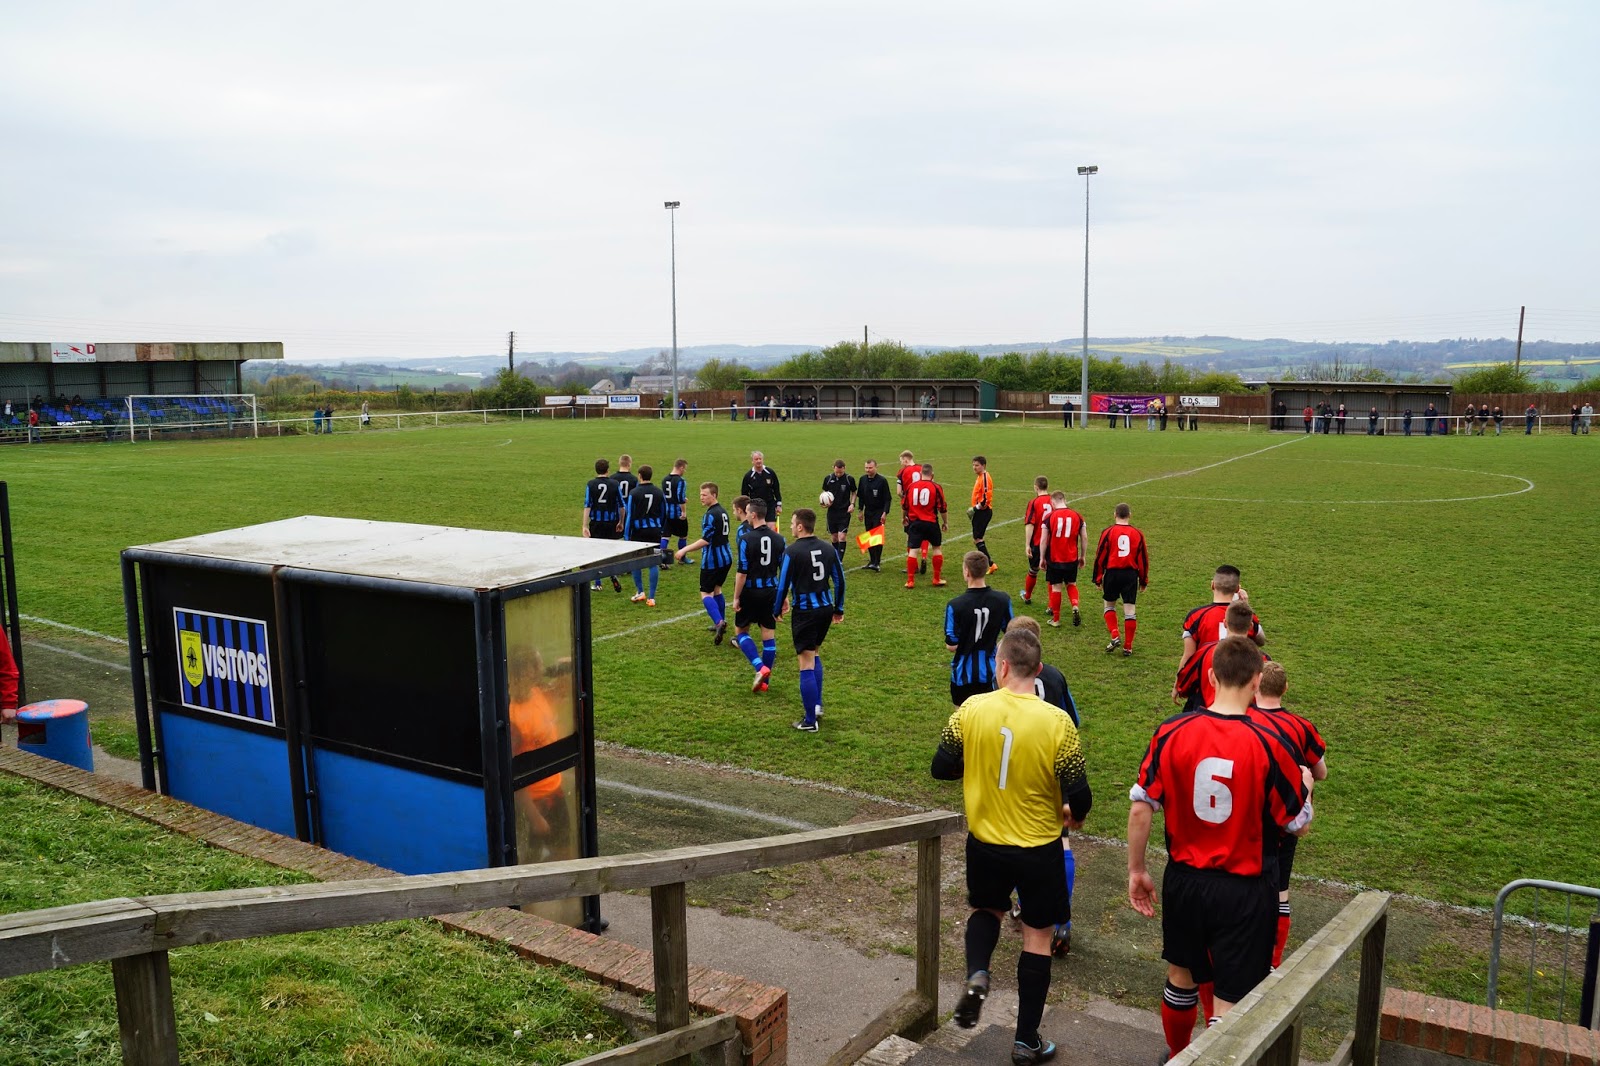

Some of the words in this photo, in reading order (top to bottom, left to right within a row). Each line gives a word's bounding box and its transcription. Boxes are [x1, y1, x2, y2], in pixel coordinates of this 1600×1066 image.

[86, 344, 96, 354] D
[598, 483, 608, 503] 2
[665, 480, 672, 499] 3
[912, 487, 930, 506] 10
[645, 494, 653, 514] 7
[722, 512, 730, 536] 6
[1056, 517, 1072, 538] 11
[760, 536, 771, 566] 9
[1117, 534, 1131, 557] 9
[810, 550, 825, 581] 5
[974, 606, 990, 643] 11
[202, 643, 268, 688] VISITORS
[999, 726, 1014, 790] 1
[1192, 757, 1235, 824] 6
